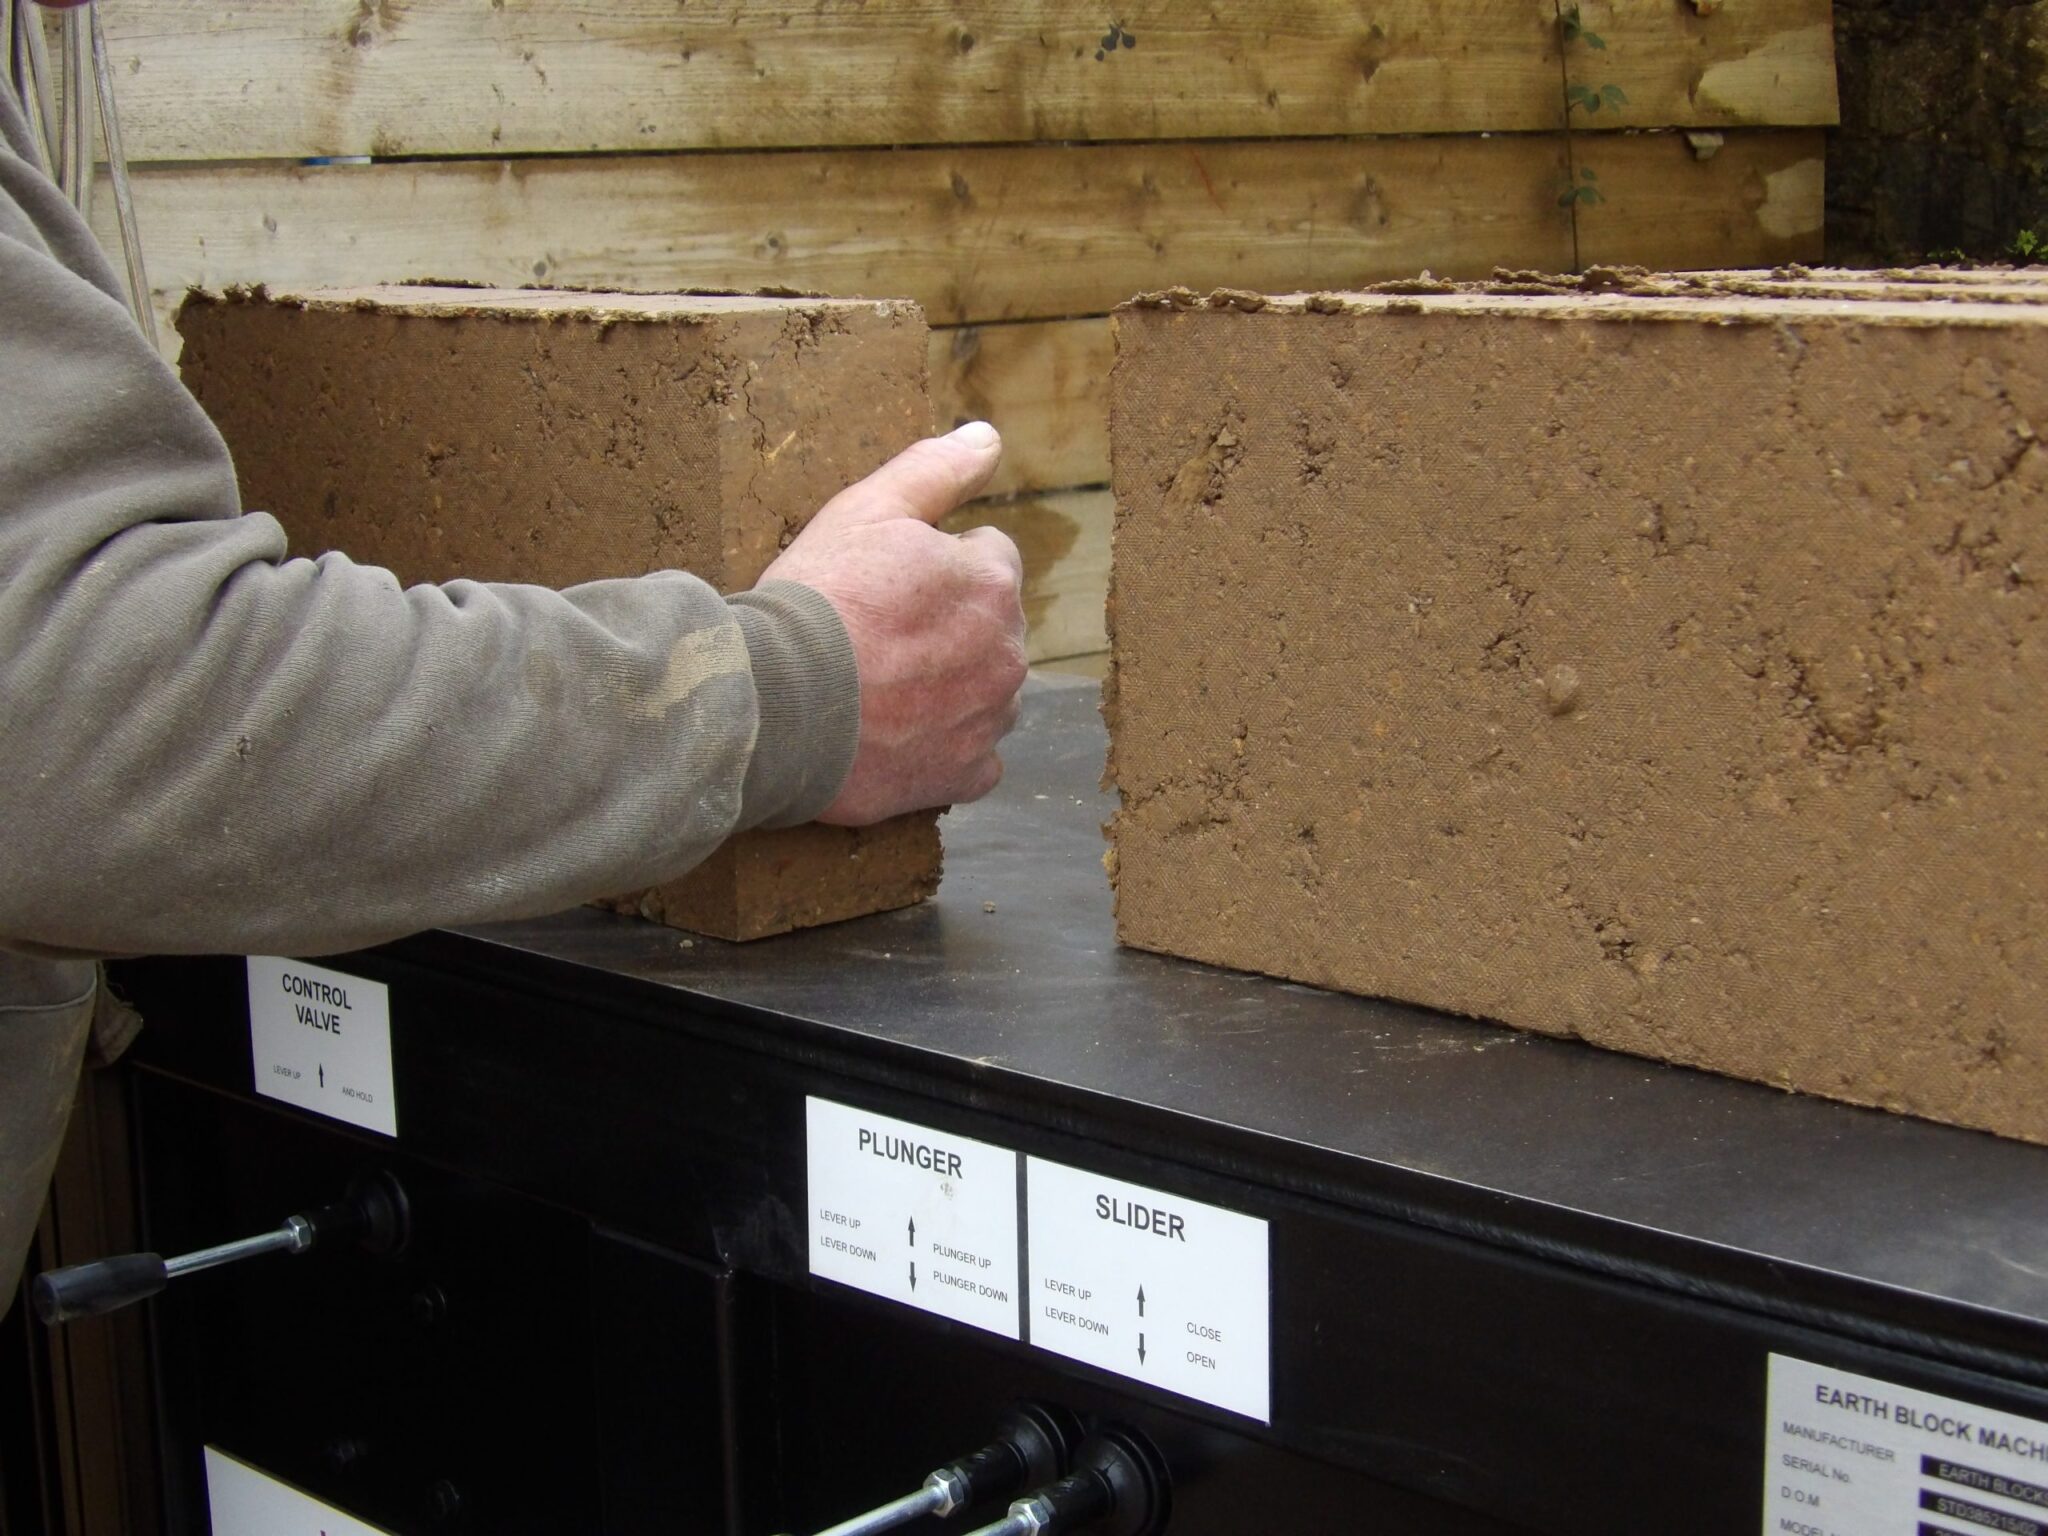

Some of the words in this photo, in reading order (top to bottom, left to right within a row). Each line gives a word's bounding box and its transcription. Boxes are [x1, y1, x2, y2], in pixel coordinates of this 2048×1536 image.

[282, 973, 352, 1010] CONTROL
[295, 1003, 341, 1035] VALVE
[273, 1064, 291, 1078] LEVER
[291, 1069, 301, 1080] UP
[342, 1086, 355, 1097] AND
[356, 1090, 373, 1103] HOLD
[859, 1128, 963, 1179] PLUNGER
[820, 1209, 847, 1226] LEVER
[849, 1218, 861, 1230] UP
[1095, 1194, 1186, 1242] SLIDER
[820, 1236, 848, 1253] LEVER
[849, 1244, 877, 1262] DOWN
[933, 1243, 977, 1266] PLUNGER
[978, 1257, 992, 1269] UP
[933, 1270, 977, 1293] PLUNGER
[979, 1284, 1008, 1303] DOWN
[1045, 1278, 1076, 1297] LEVER
[1078, 1288, 1092, 1301] UP
[1045, 1306, 1076, 1325] LEVER
[1078, 1317, 1109, 1336] DOWN
[1186, 1322, 1222, 1342] CLOSE
[1186, 1351, 1216, 1370] OPEN
[1816, 1384, 1888, 1419] EARTH
[1895, 1405, 1971, 1442] BLOCK
[1783, 1421, 1895, 1462] MANUFACTURER
[1782, 1454, 1829, 1478] SERIAL
[1939, 1463, 1991, 1488] EARTH
